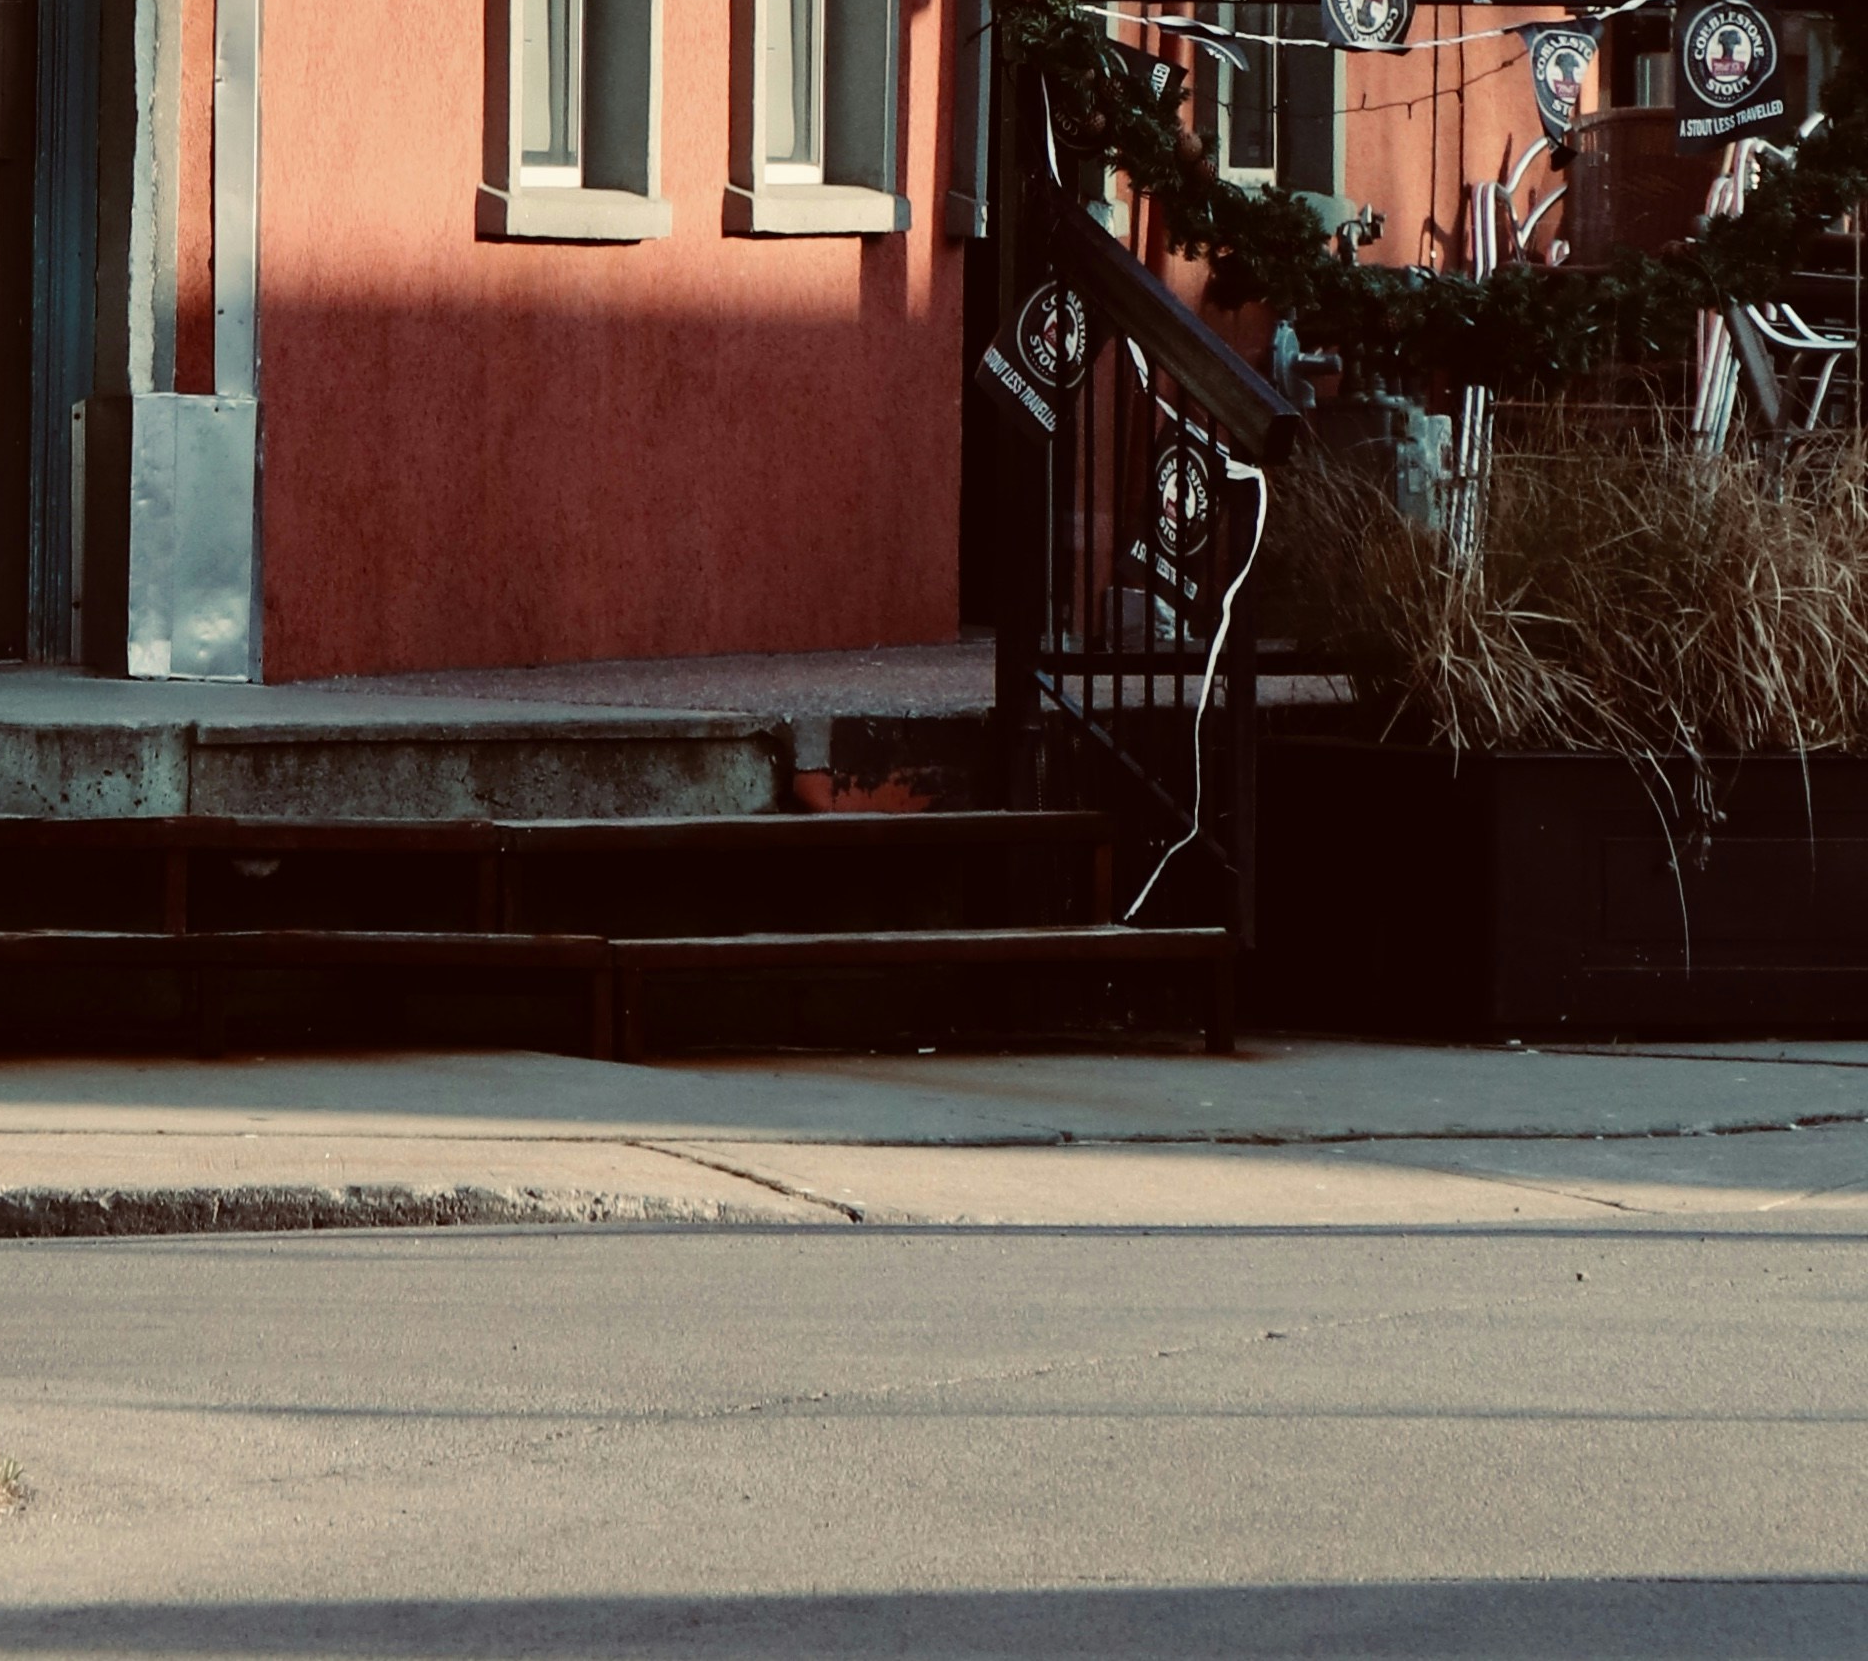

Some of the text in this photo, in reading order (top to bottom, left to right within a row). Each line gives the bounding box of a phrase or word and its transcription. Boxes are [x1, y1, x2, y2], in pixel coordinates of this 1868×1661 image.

[1705, 76, 1752, 96] STOUT
[1687, 119, 1713, 137] STOUT
[1713, 115, 1735, 135] LESS
